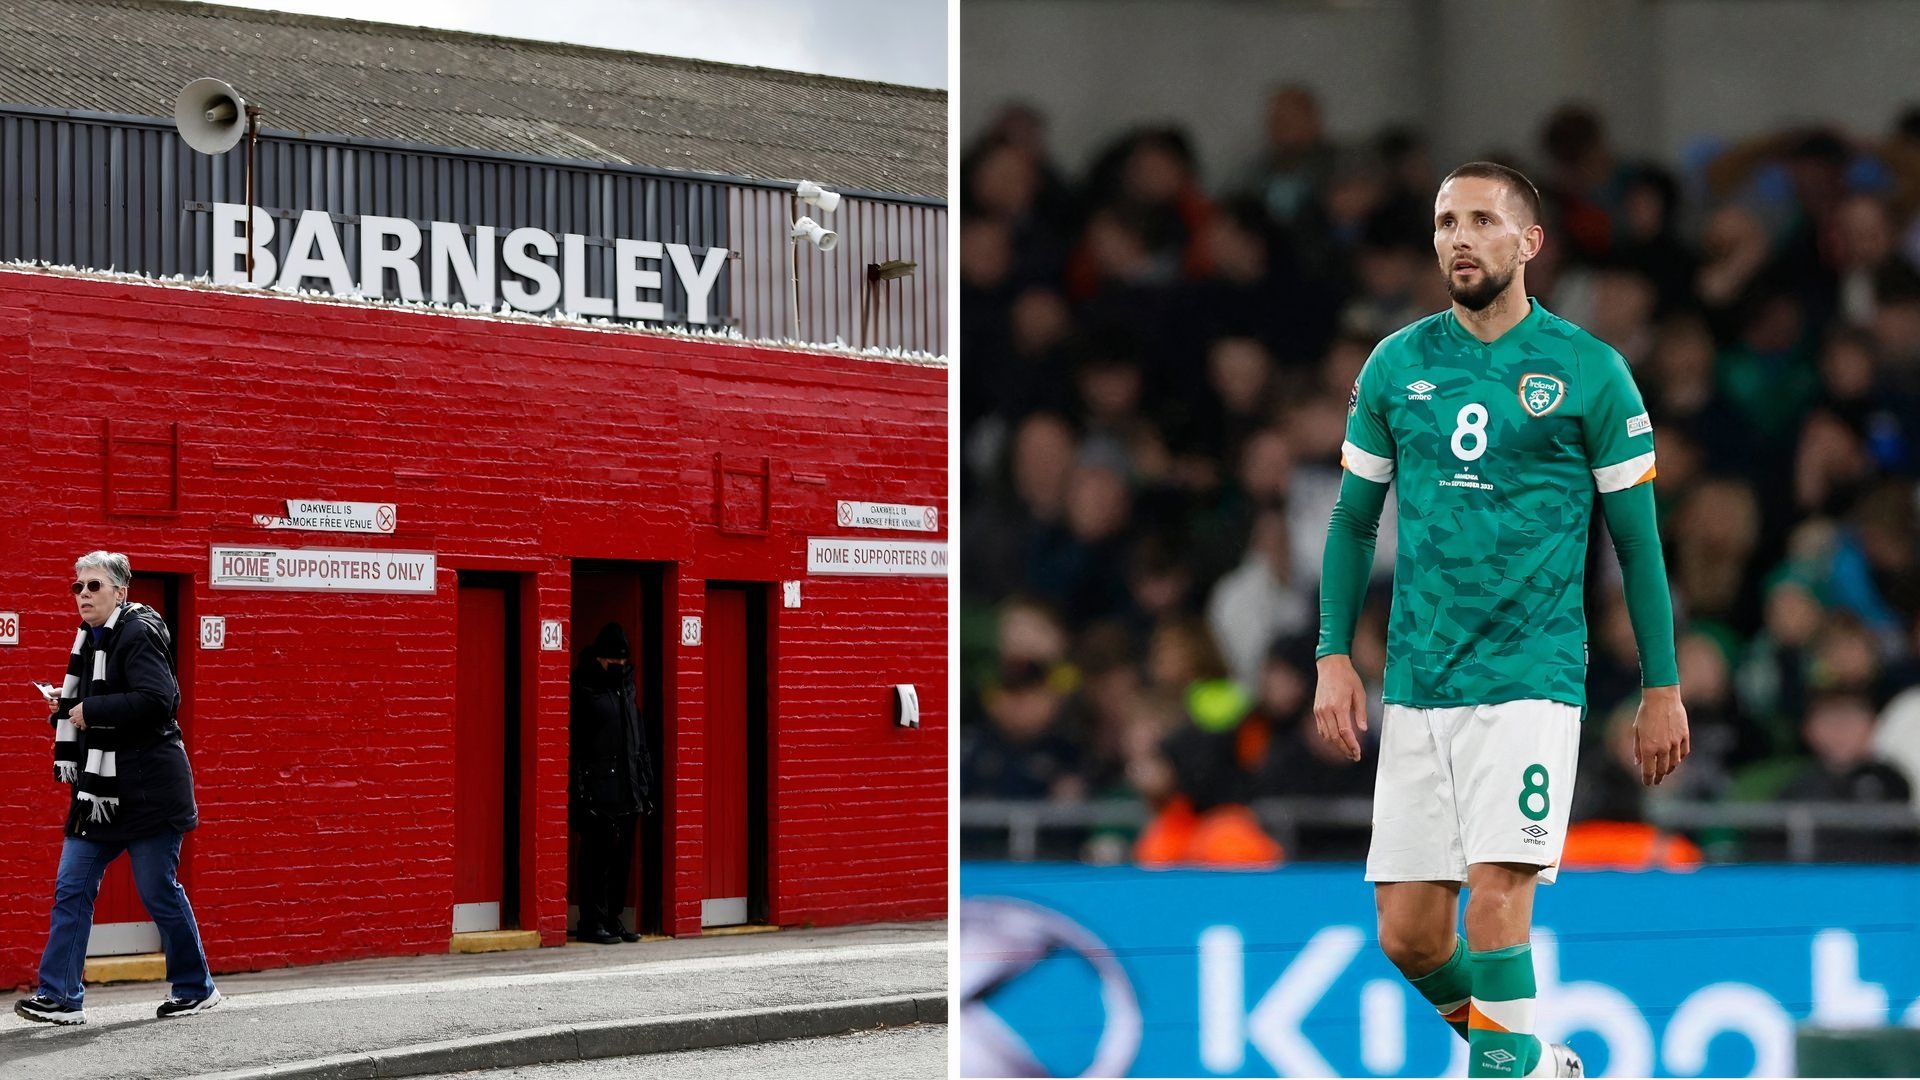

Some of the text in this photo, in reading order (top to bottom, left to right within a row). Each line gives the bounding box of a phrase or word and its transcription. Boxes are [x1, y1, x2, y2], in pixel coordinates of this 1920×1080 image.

[212, 201, 728, 324] BARNSLEY
[1529, 379, 1556, 391] Ireland
[1408, 393, 1432, 401] umbro
[1451, 403, 1489, 462] 8
[300, 503, 352, 515] OAKWELL IS
[278, 517, 372, 530] A SMOKE FREE VENUE
[816, 548, 849, 564] HOME
[854, 548, 927, 566] SUPPORTERS
[222, 556, 425, 582] HOME SUPPORTERS ONLY
[204, 622, 221, 643] 35
[544, 626, 558, 645] 34
[684, 622, 697, 641] 33
[1518, 763, 1550, 821] 8
[1523, 838, 1546, 846] umbro
[1482, 1062, 1512, 1072] umbro
